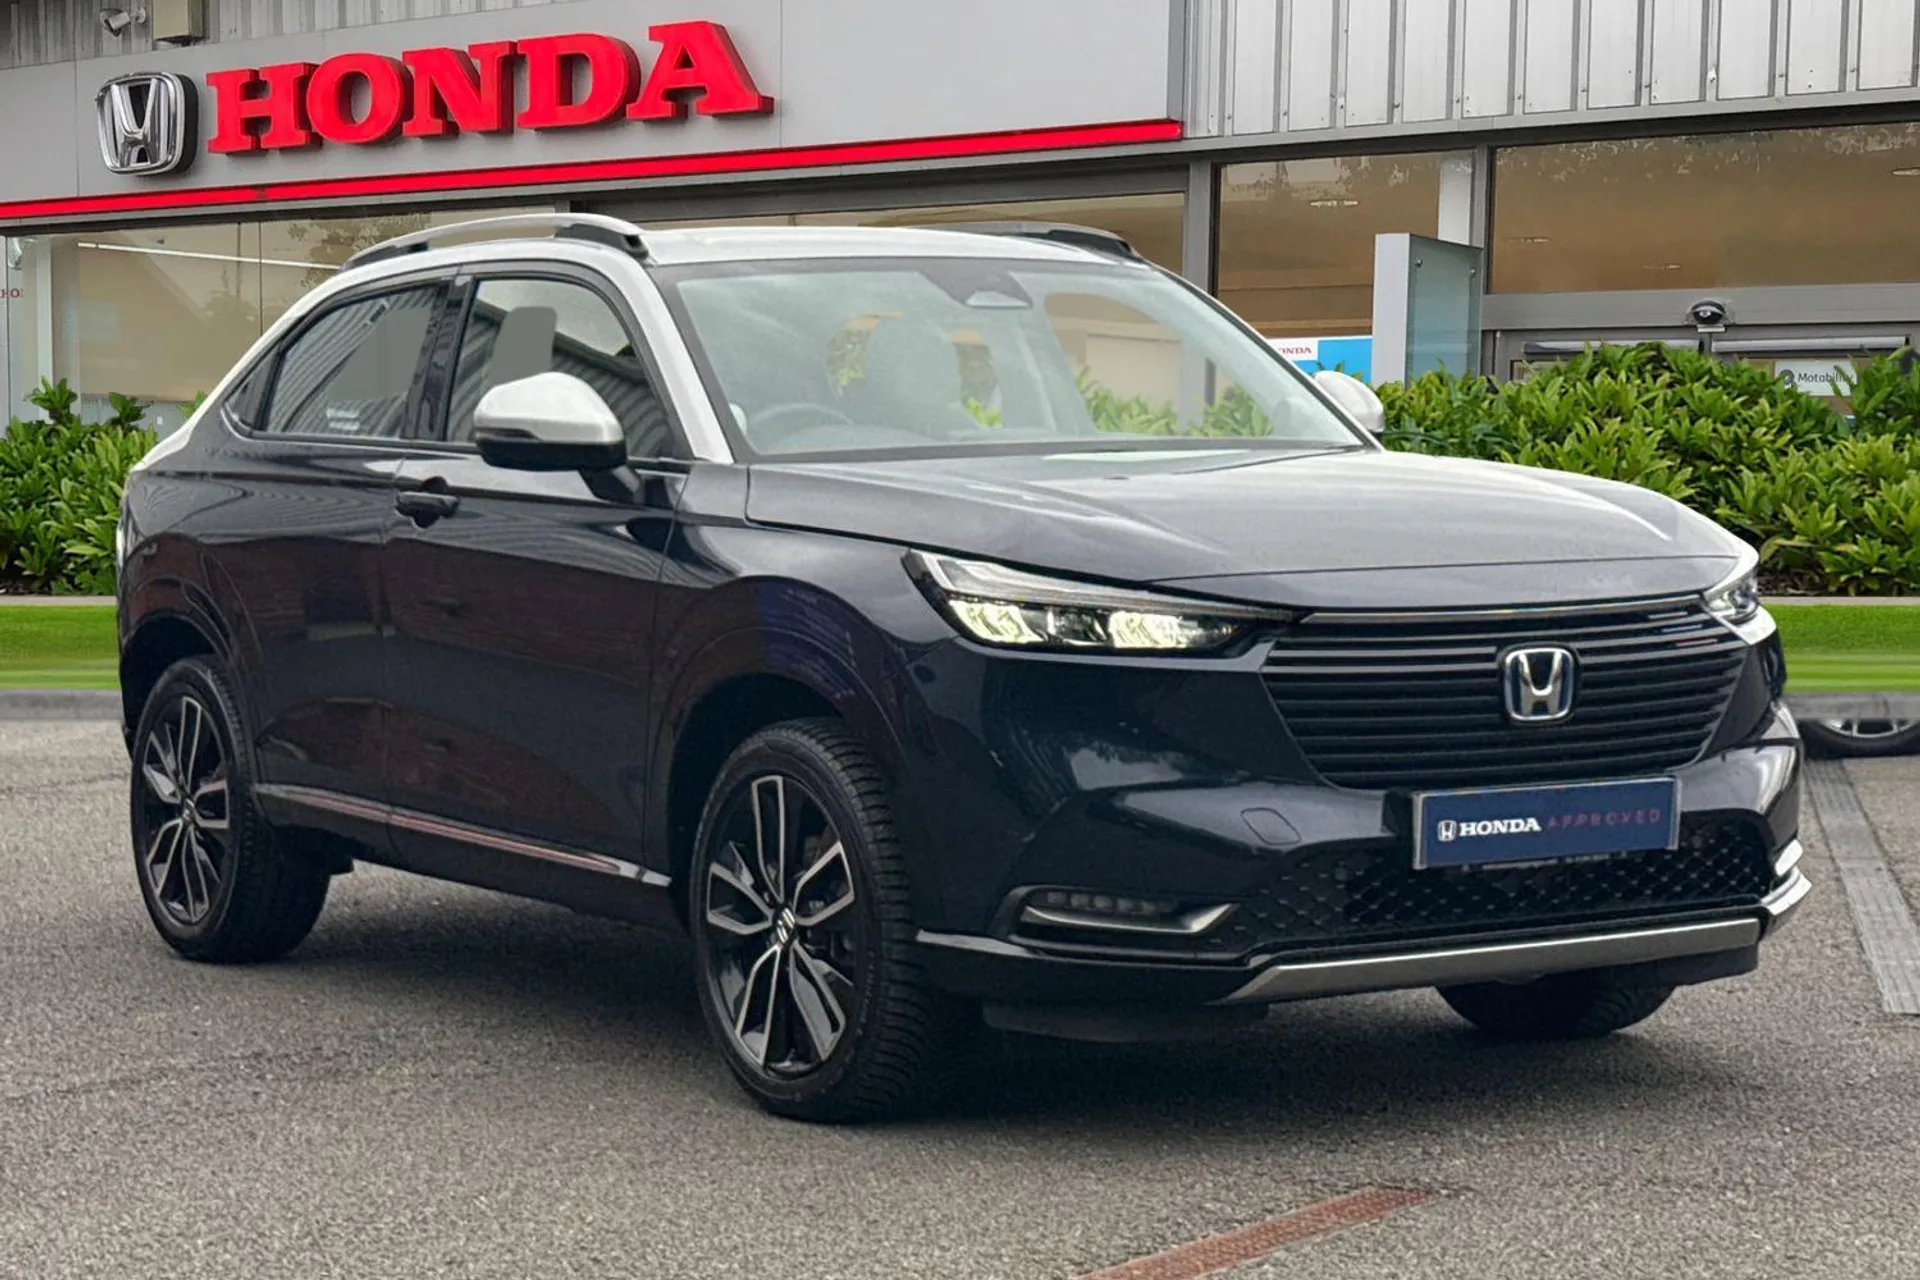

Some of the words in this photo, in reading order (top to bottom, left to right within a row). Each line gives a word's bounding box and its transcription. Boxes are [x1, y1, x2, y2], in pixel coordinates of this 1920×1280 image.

[206, 20, 774, 154] HONDA
[1798, 372, 1854, 383] Motabili
[1459, 817, 1542, 836] HONDA
[1547, 809, 1661, 829] APPROVED
